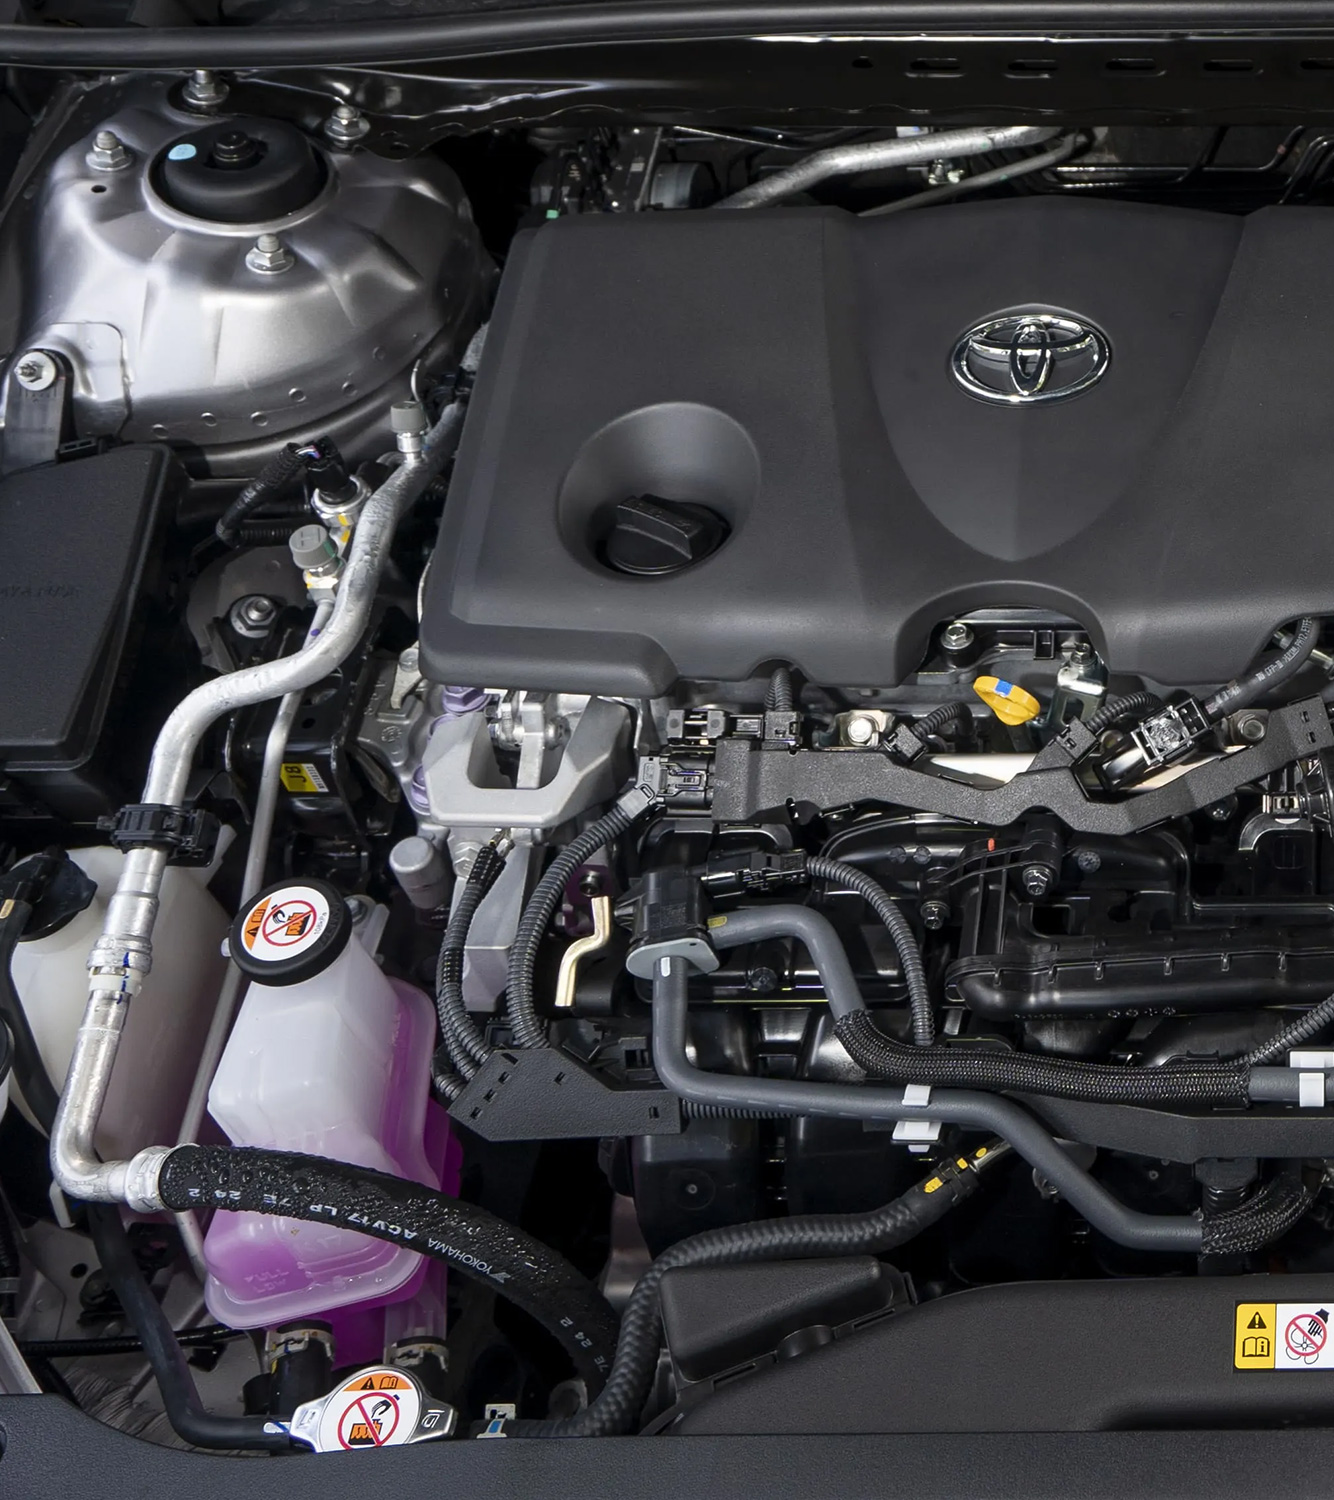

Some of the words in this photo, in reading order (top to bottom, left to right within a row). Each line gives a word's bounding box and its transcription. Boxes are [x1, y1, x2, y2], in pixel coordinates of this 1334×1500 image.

[214, 1189, 241, 1200] 24
[309, 1203, 338, 1216] LP
[347, 1212, 418, 1240] ACV17
[428, 1237, 493, 1275] YOKOHAMA
[560, 1316, 574, 1327] 2
[574, 1331, 593, 1348] 24
